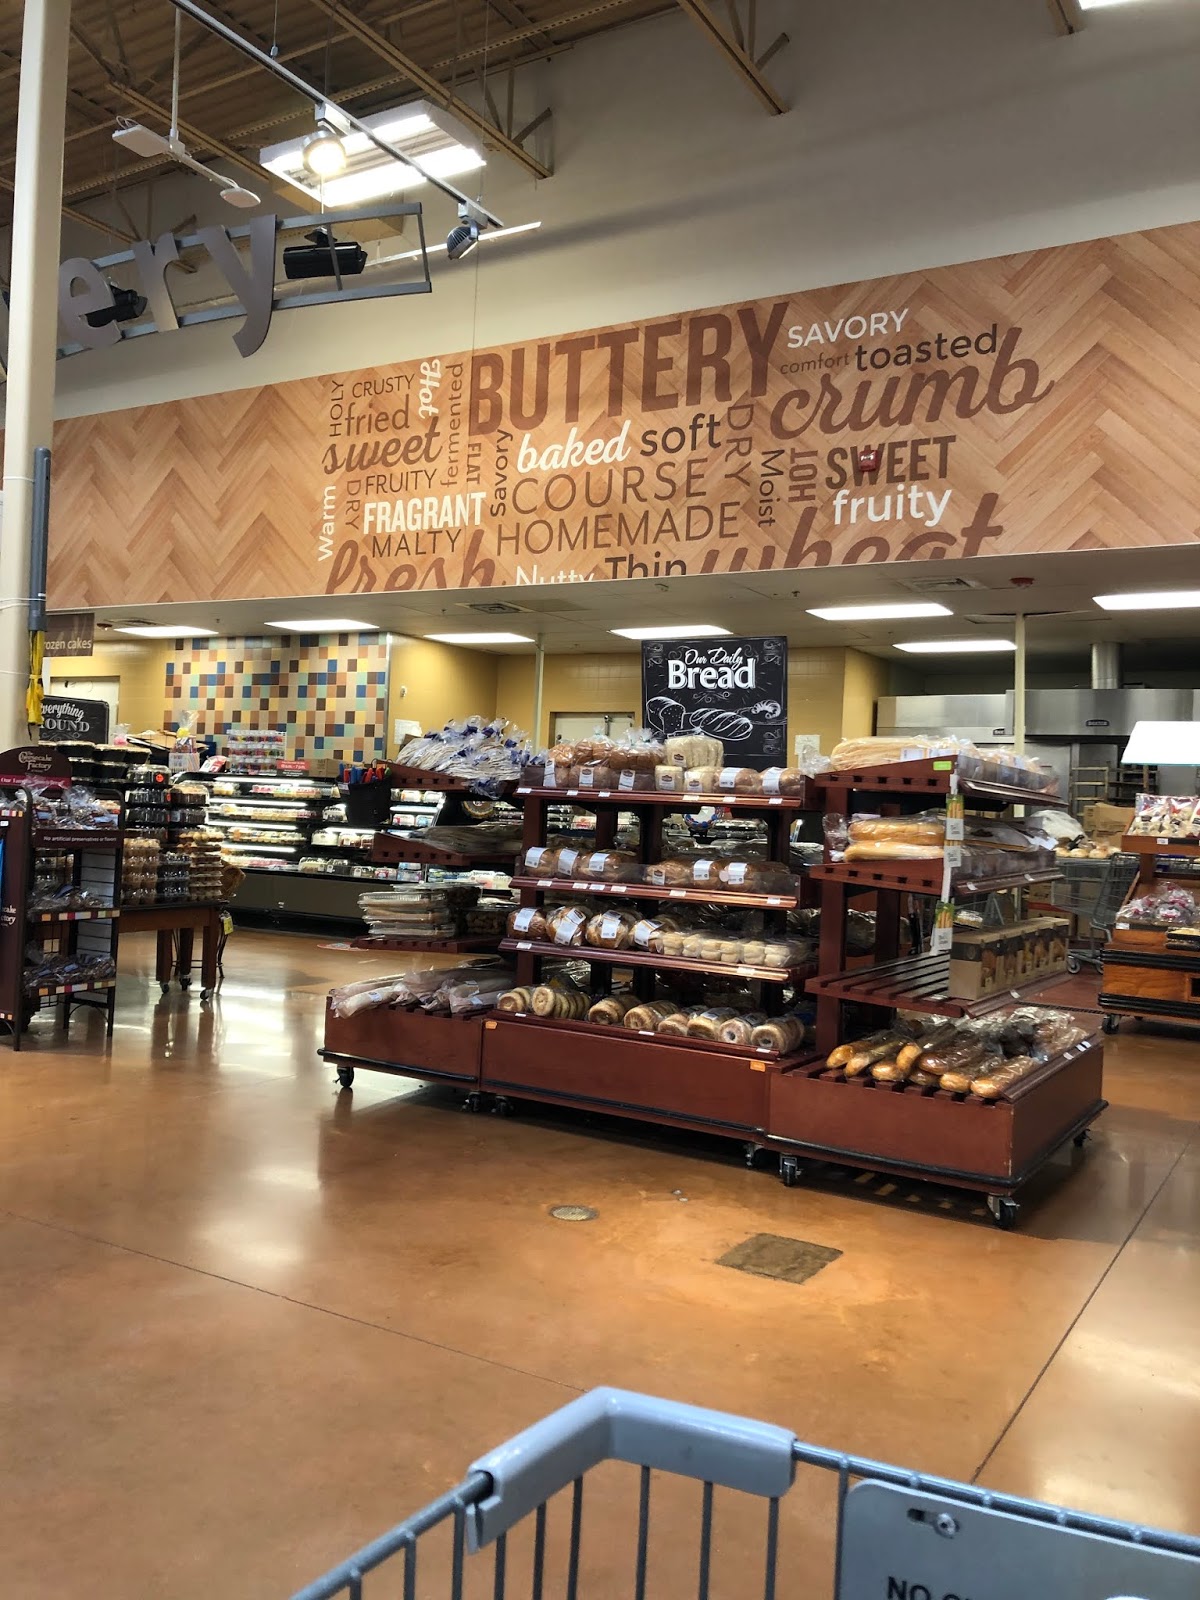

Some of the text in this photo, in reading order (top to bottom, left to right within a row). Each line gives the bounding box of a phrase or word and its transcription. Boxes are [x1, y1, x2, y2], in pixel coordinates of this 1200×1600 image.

[59, 214, 277, 358] ery
[787, 308, 909, 348] SAVORY
[854, 323, 999, 372] toasted
[351, 374, 415, 399] CRUSTY
[418, 358, 441, 418] Hot
[468, 302, 789, 436] BUTTERY
[770, 326, 1055, 440] crumb
[780, 352, 850, 376] comfort
[328, 379, 344, 438] HOLY
[344, 394, 410, 436] fried
[441, 362, 464, 488] fermented
[322, 416, 443, 475] sweet
[516, 420, 632, 474] baked
[640, 413, 721, 457] soft
[724, 403, 754, 489] DRY
[365, 469, 437, 496] FRUITY
[467, 442, 482, 485] FLAT
[490, 429, 513, 517] Savory
[512, 457, 709, 515] COURSE
[789, 447, 818, 503] HOT
[825, 435, 956, 490] SWEET
[346, 479, 361, 530] DRY
[363, 491, 486, 534] FRAGRANT
[758, 450, 785, 528] Moist
[833, 485, 952, 527] fruity
[318, 484, 336, 561] Warm
[372, 528, 462, 558] MALTY
[497, 501, 741, 556] HOMEMADE
[67, 637, 92, 649] cakes
[685, 647, 743, 670] Our Daily
[668, 658, 756, 690] Bread
[40, 718, 90, 732] OUND
[41, 703, 84, 722] verything
[887, 1576, 931, 1600] NO
